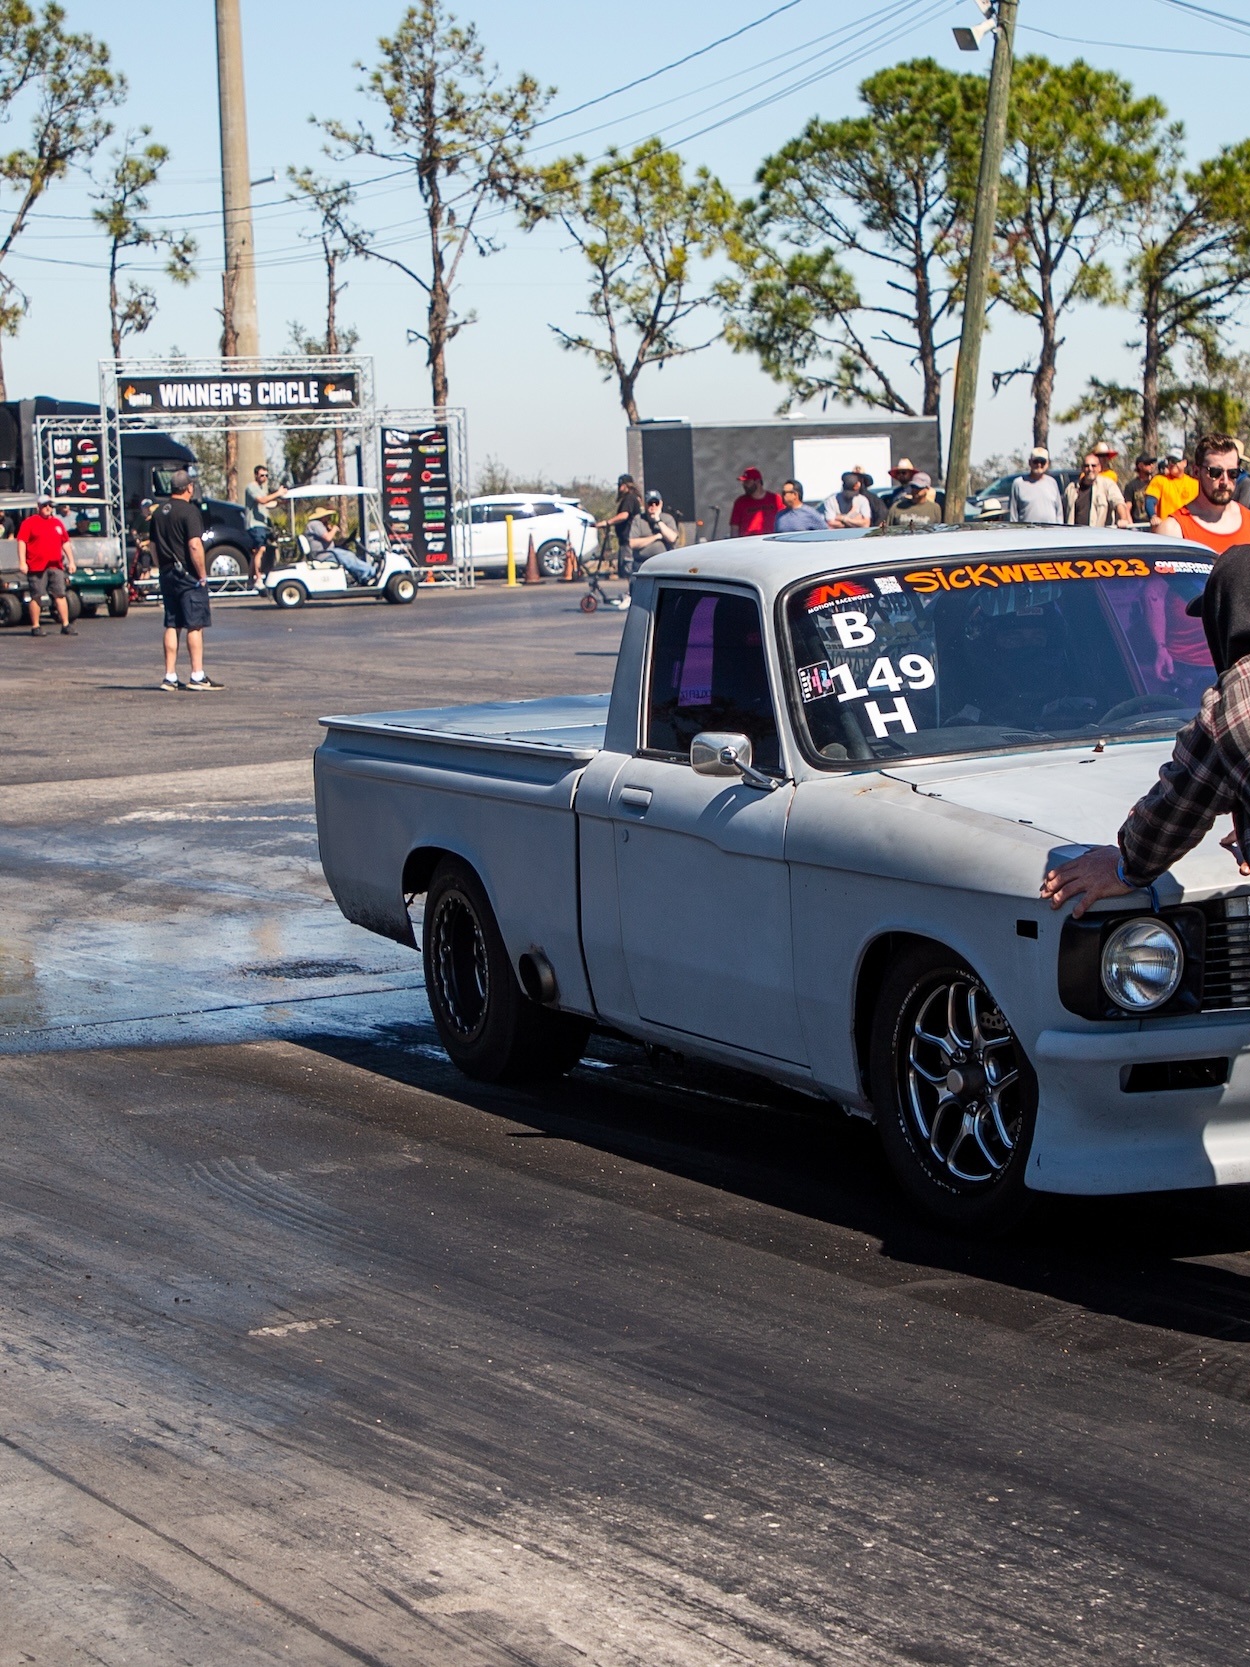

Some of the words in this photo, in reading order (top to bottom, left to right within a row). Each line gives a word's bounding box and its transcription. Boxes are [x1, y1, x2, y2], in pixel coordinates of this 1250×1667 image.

[159, 383, 251, 406] WINNER'S
[257, 381, 319, 404] CIRCLE
[1155, 561, 1214, 571] OVERDRIV
[808, 600, 835, 614] MOTION
[835, 593, 875, 605] RACEWORKS
[831, 610, 876, 649] B
[828, 653, 936, 703] 149
[864, 696, 918, 739] H
